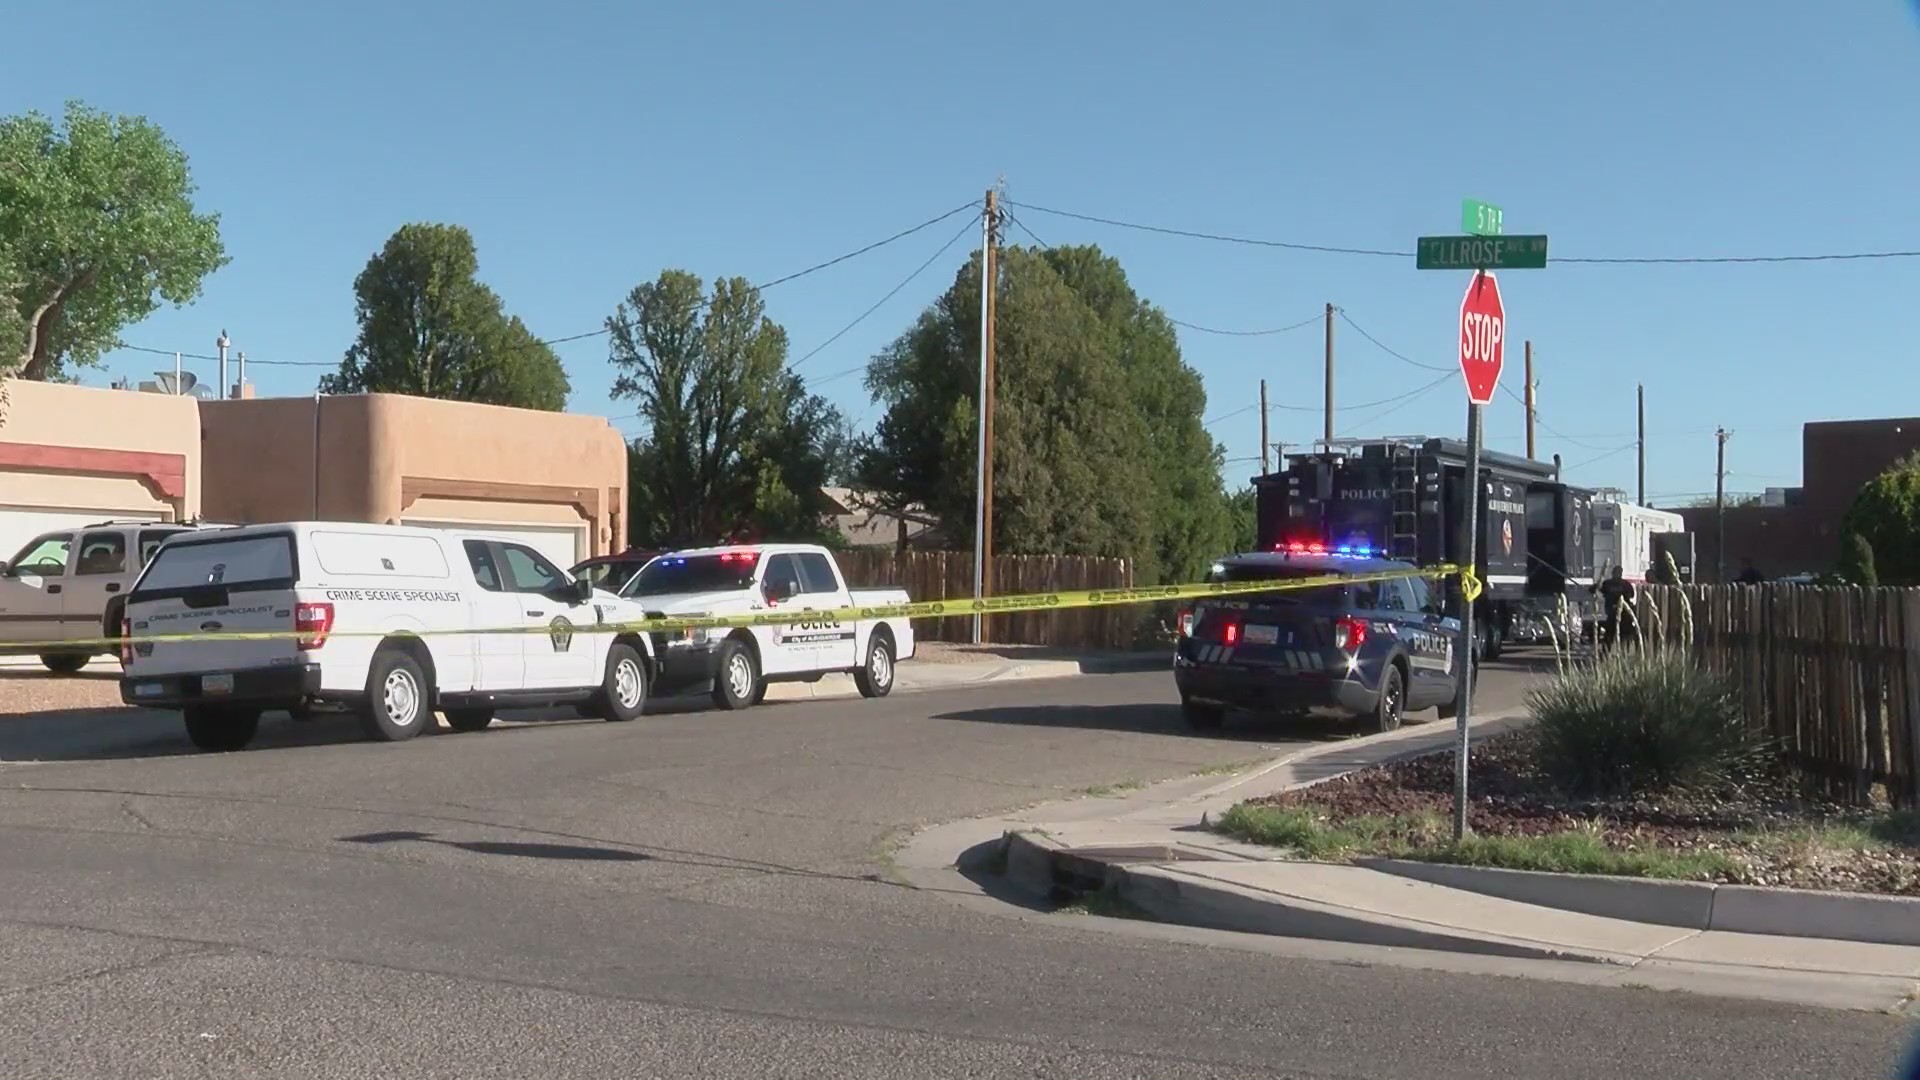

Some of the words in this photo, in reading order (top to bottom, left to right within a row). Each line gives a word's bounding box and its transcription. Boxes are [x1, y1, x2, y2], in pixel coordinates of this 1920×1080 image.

[1463, 311, 1502, 362] STOP
[1341, 489, 1390, 500] POLICE
[326, 590, 363, 601] CRIME
[365, 591, 402, 602] SCENE
[404, 591, 461, 602] SPECIALIST
[149, 612, 178, 622] CRIME
[182, 610, 214, 619] SCENE
[217, 605, 274, 616] SPECIALIST
[1413, 633, 1446, 655] POLICE
